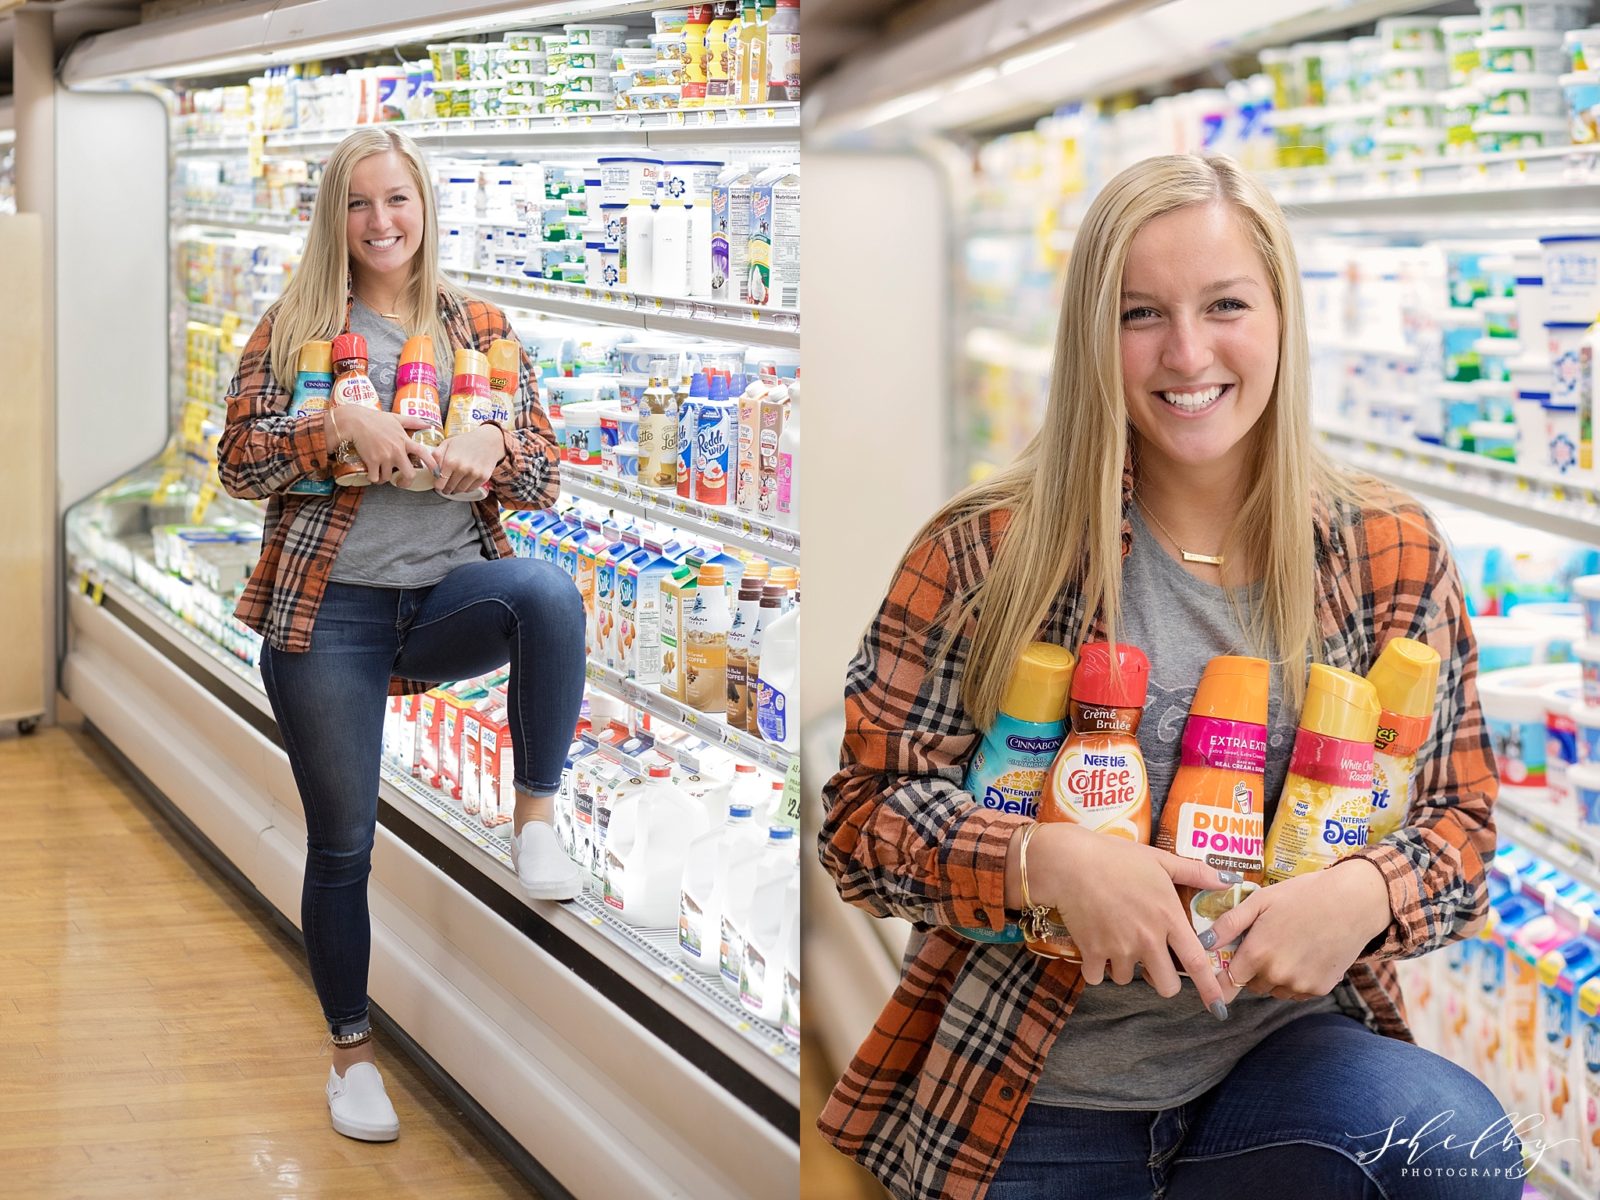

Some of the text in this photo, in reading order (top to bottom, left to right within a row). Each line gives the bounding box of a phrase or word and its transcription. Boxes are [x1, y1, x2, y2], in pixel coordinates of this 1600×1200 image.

[697, 429, 724, 456] Reddi
[708, 444, 726, 456] wip
[1210, 735, 1248, 750] EXTRA
[1214, 760, 1231, 769] REAL
[1231, 763, 1252, 771] CREAM
[1340, 758, 1363, 772] White
[1082, 785, 1135, 808] mate
[1208, 857, 1262, 871] COFFEE CREAMER
